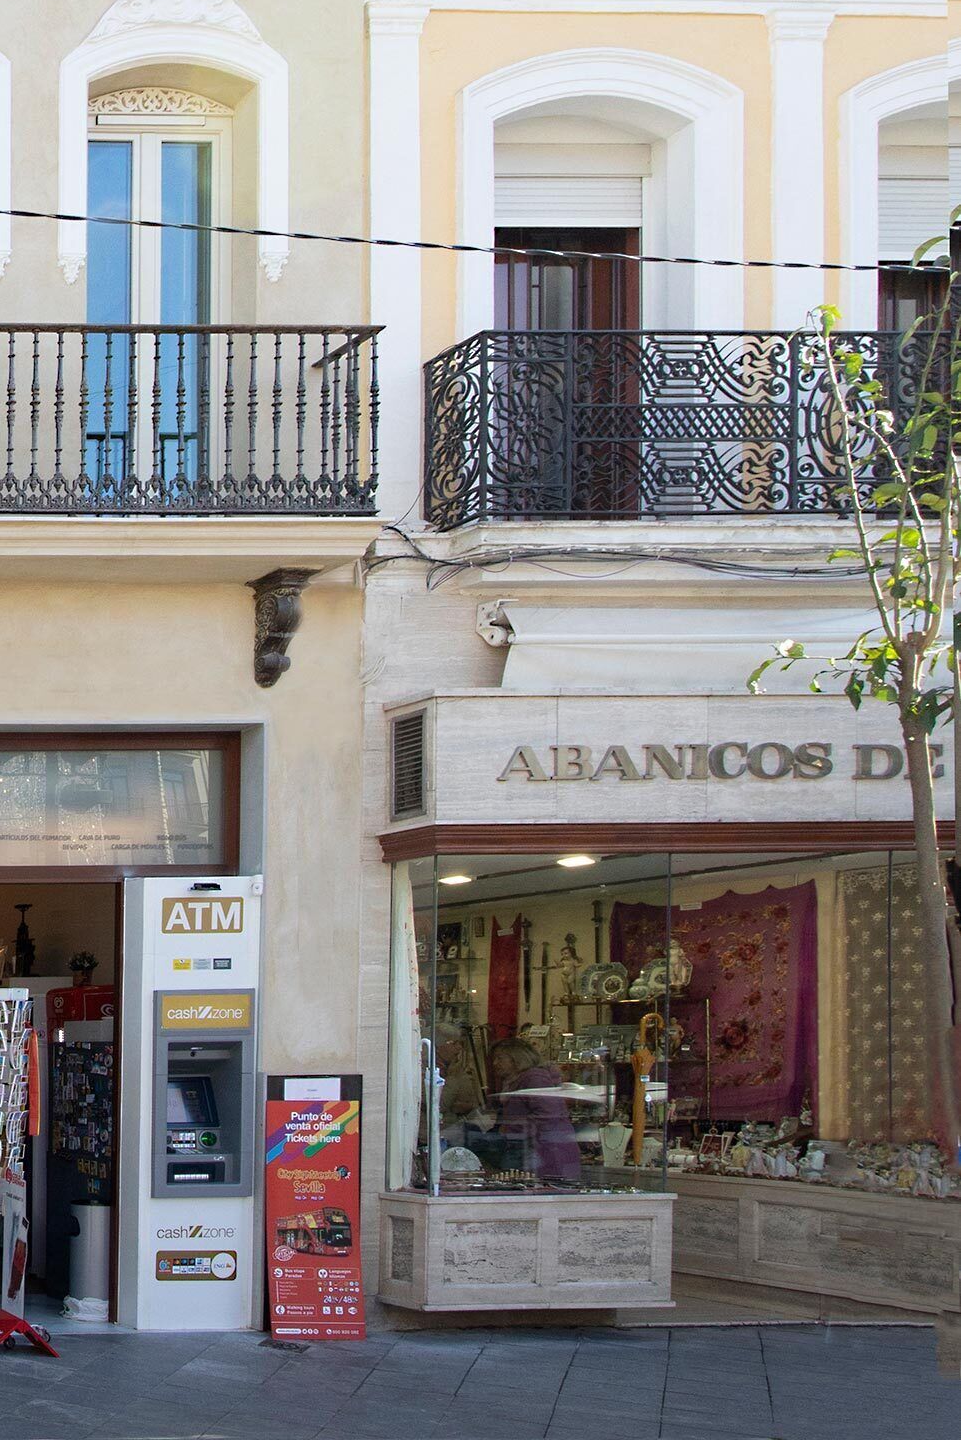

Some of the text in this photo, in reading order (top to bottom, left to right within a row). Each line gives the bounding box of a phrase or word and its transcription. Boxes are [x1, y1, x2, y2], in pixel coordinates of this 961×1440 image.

[496, 742, 834, 782] ABANICOS
[165, 902, 241, 930] ATM
[291, 1112, 332, 1121] Punto de
[285, 1121, 341, 1131] venta oficial
[285, 1133, 341, 1143] Tickets here
[293, 1181, 325, 1193] Sevilla
